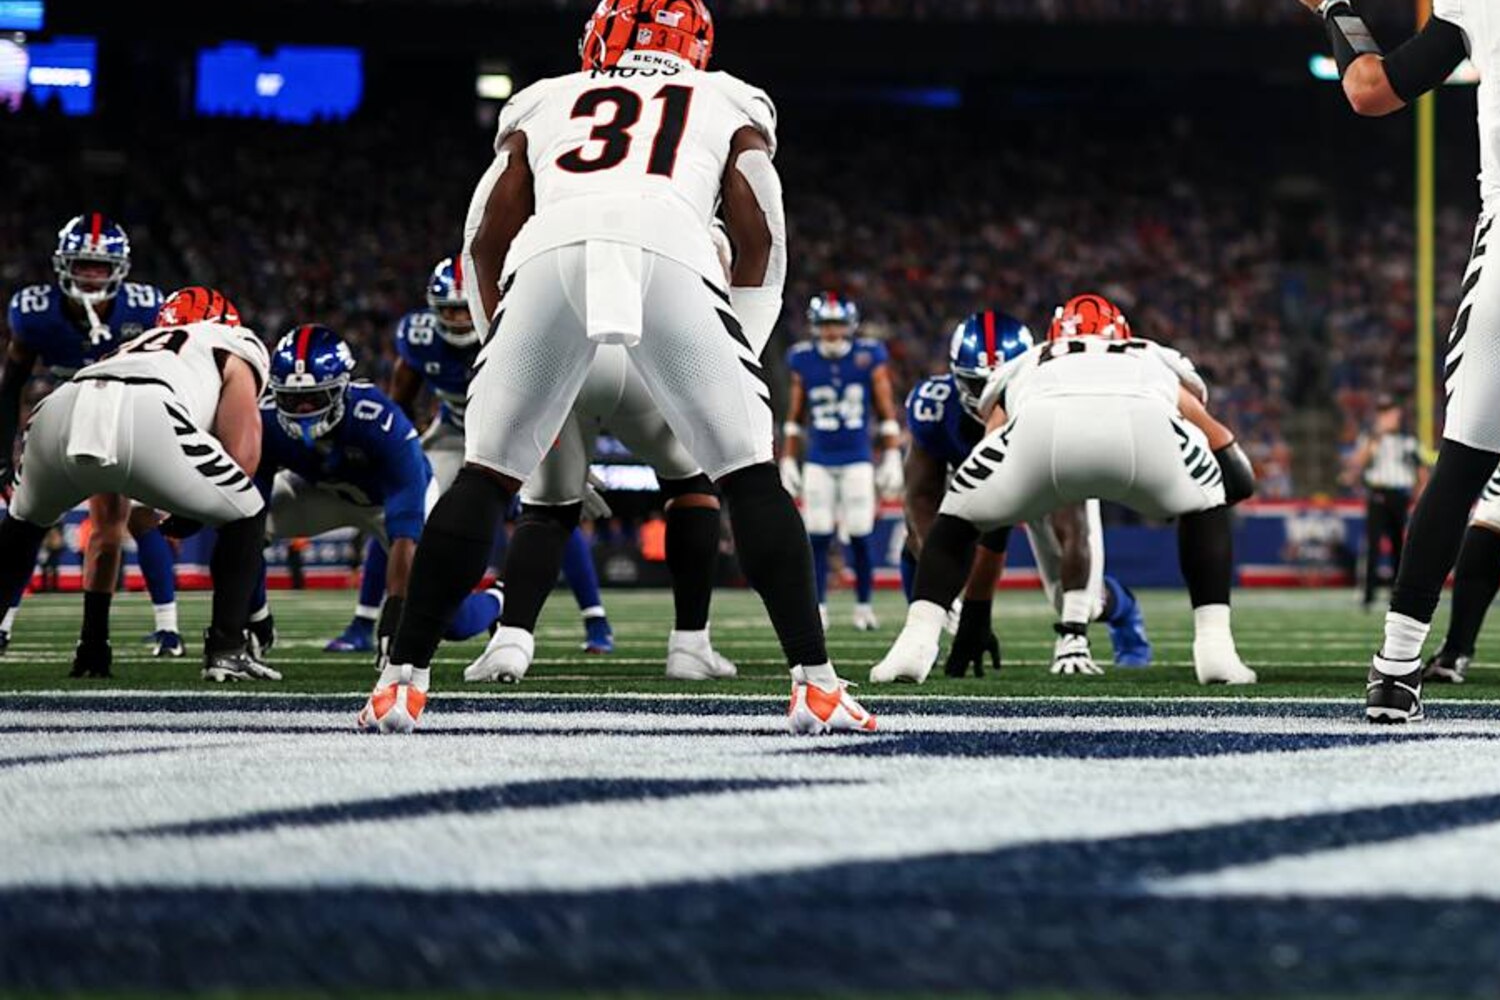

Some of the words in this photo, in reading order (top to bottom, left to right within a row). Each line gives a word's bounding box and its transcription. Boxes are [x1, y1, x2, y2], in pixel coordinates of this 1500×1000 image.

[555, 84, 694, 180] 31
[809, 385, 864, 430] 24
[913, 380, 950, 422] 93
